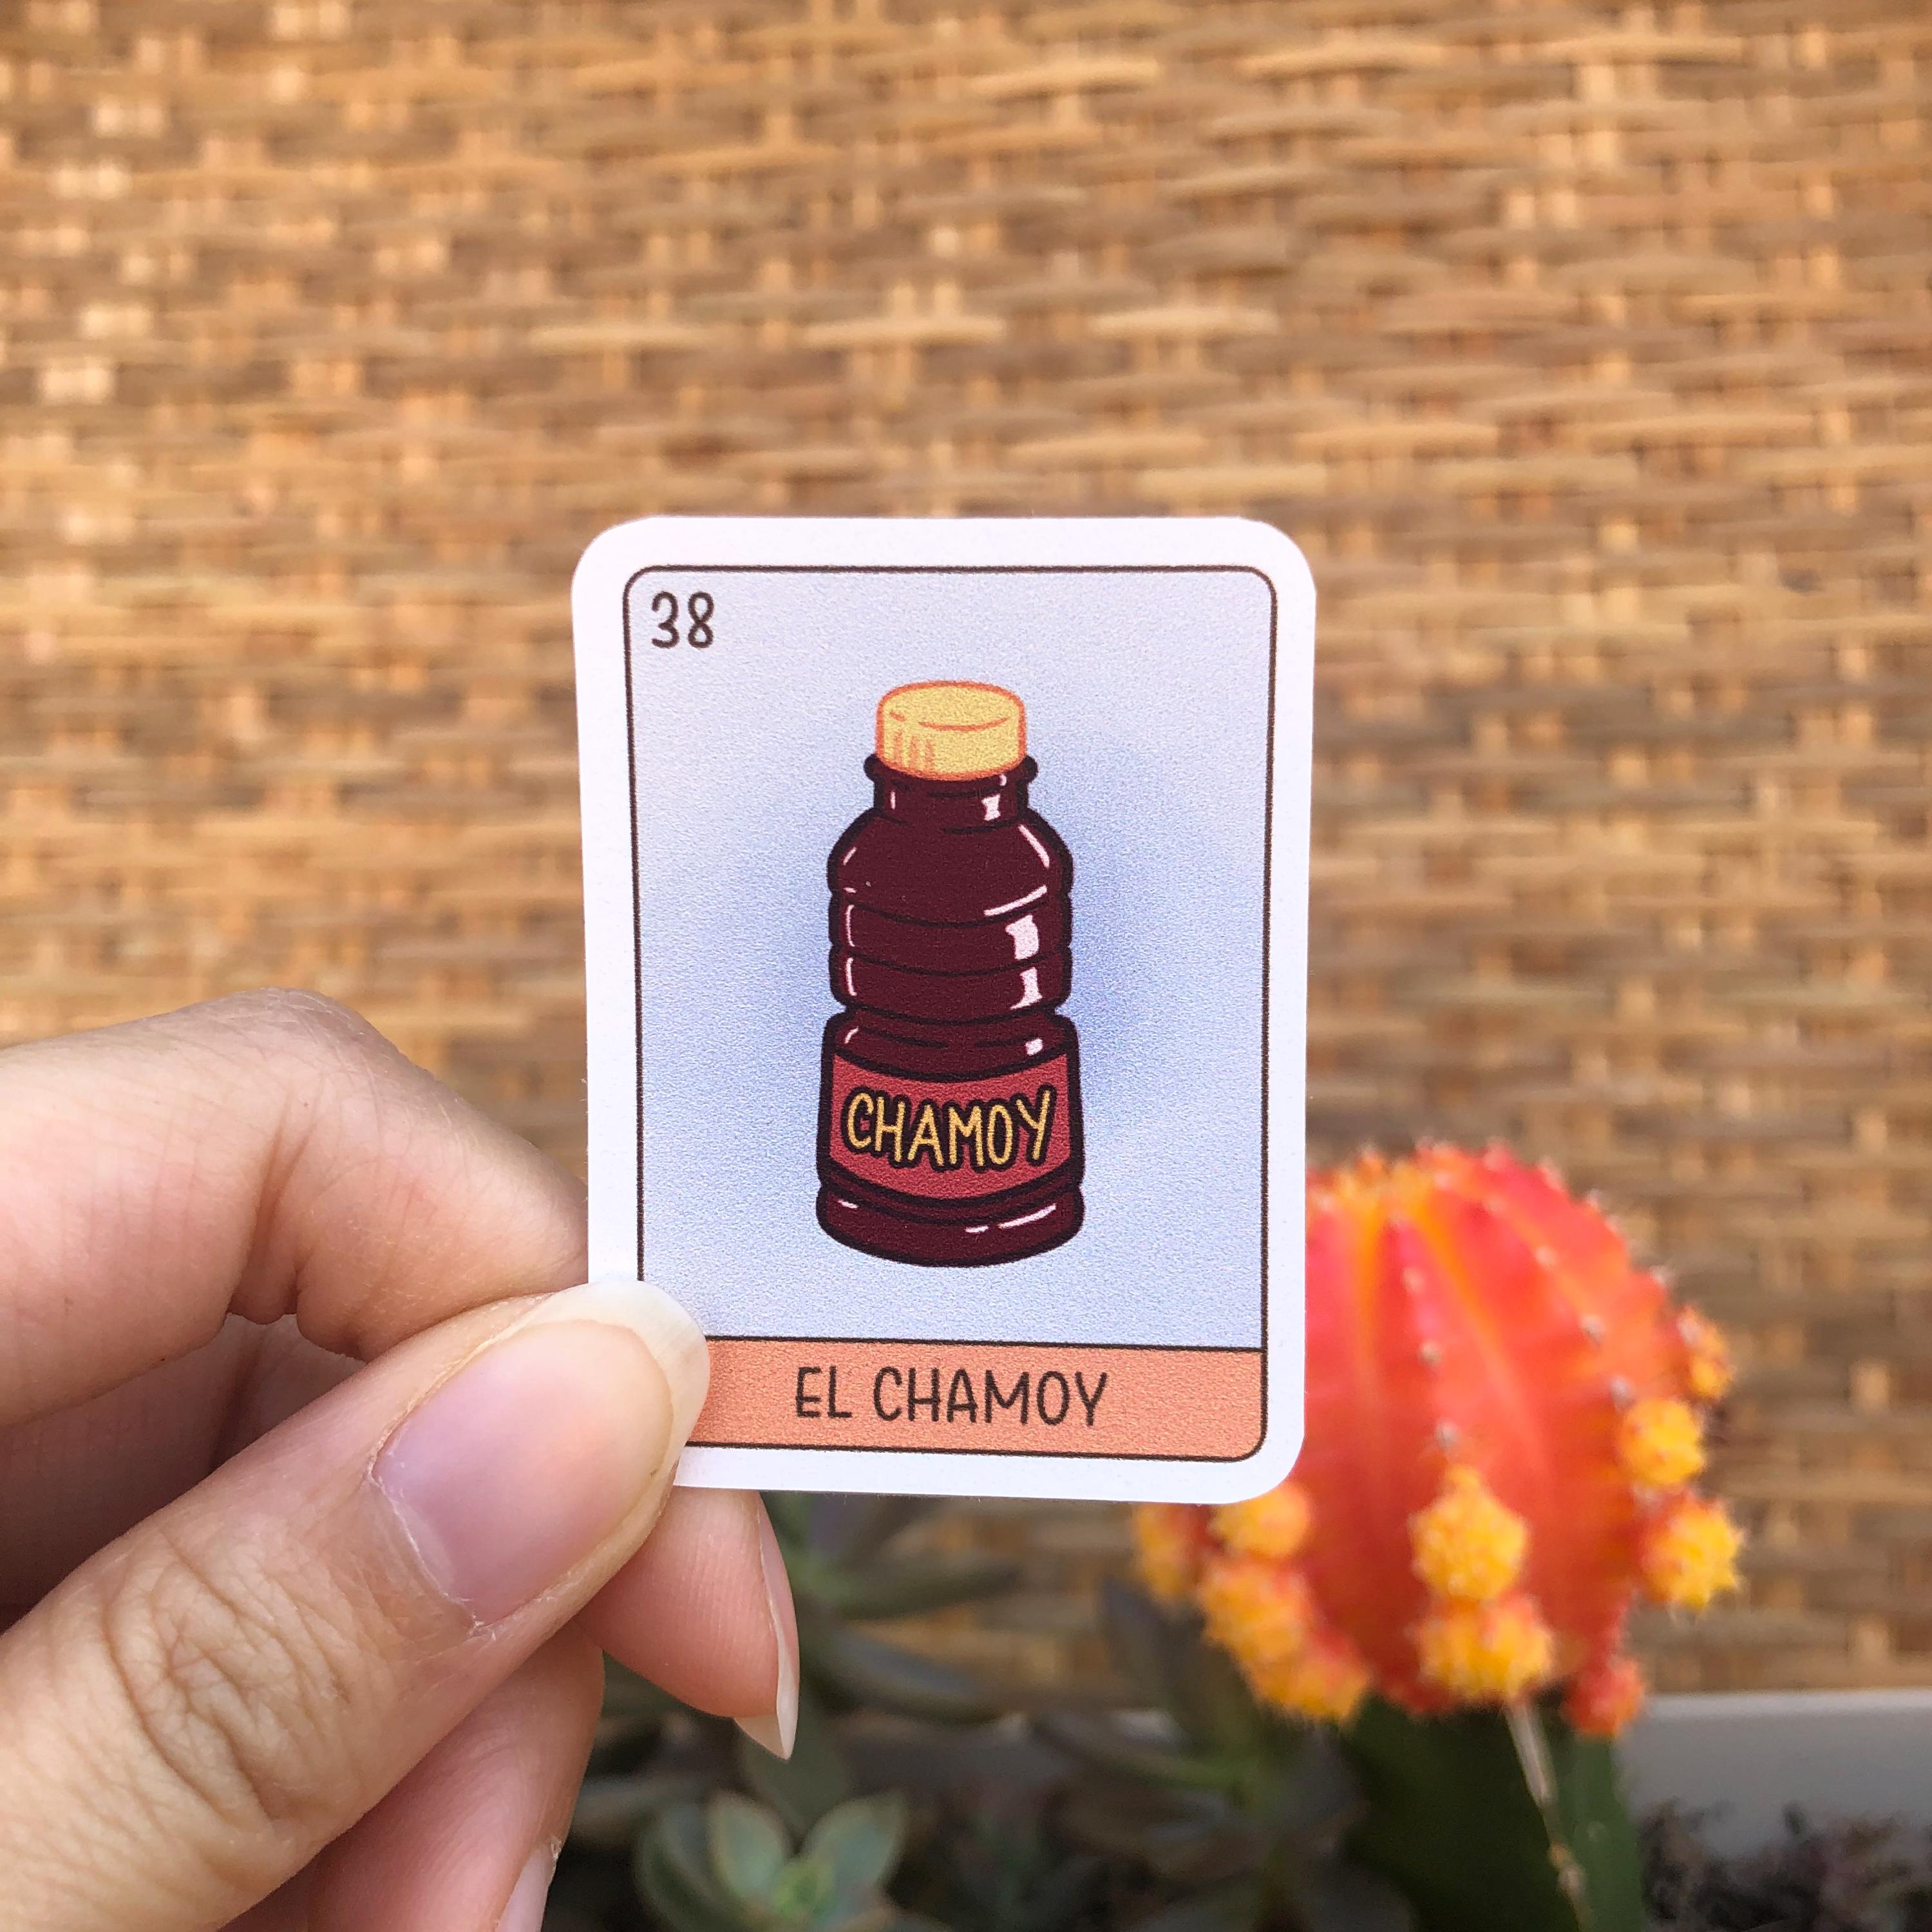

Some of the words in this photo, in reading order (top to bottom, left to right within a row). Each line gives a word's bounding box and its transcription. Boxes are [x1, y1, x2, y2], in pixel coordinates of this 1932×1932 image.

[651, 591, 715, 649] 38
[845, 1089, 1052, 1167] CHAMOY
[795, 1366, 853, 1419] EL
[873, 1367, 1108, 1428] CHAMOY
